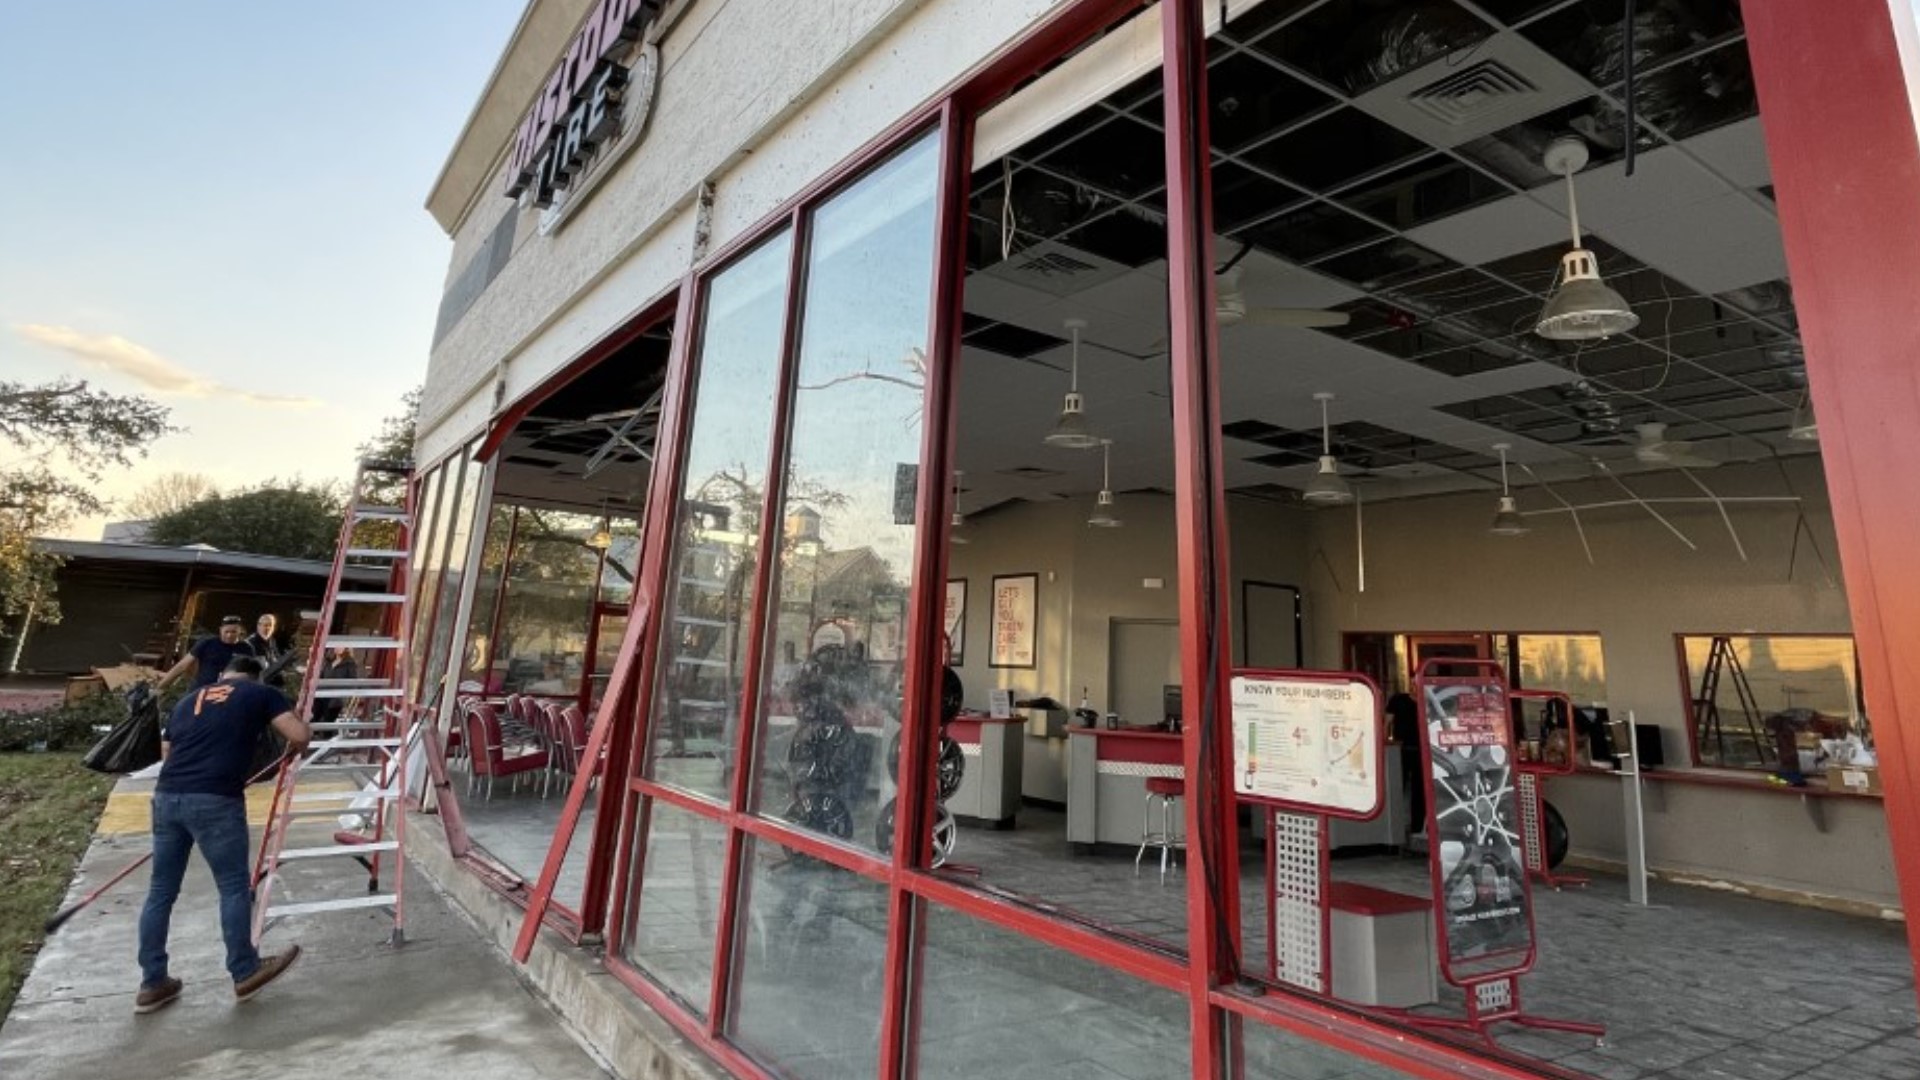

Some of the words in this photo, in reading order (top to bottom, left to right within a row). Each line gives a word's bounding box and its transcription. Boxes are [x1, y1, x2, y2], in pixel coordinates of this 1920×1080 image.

[505, 0, 642, 196] DISCOU
[535, 66, 613, 205] TIRE
[1244, 684, 1272, 695] KNOW
[1275, 686, 1300, 697] YOUR
[1303, 687, 1352, 701] NUMBERS
[1330, 725, 1340, 740] 6
